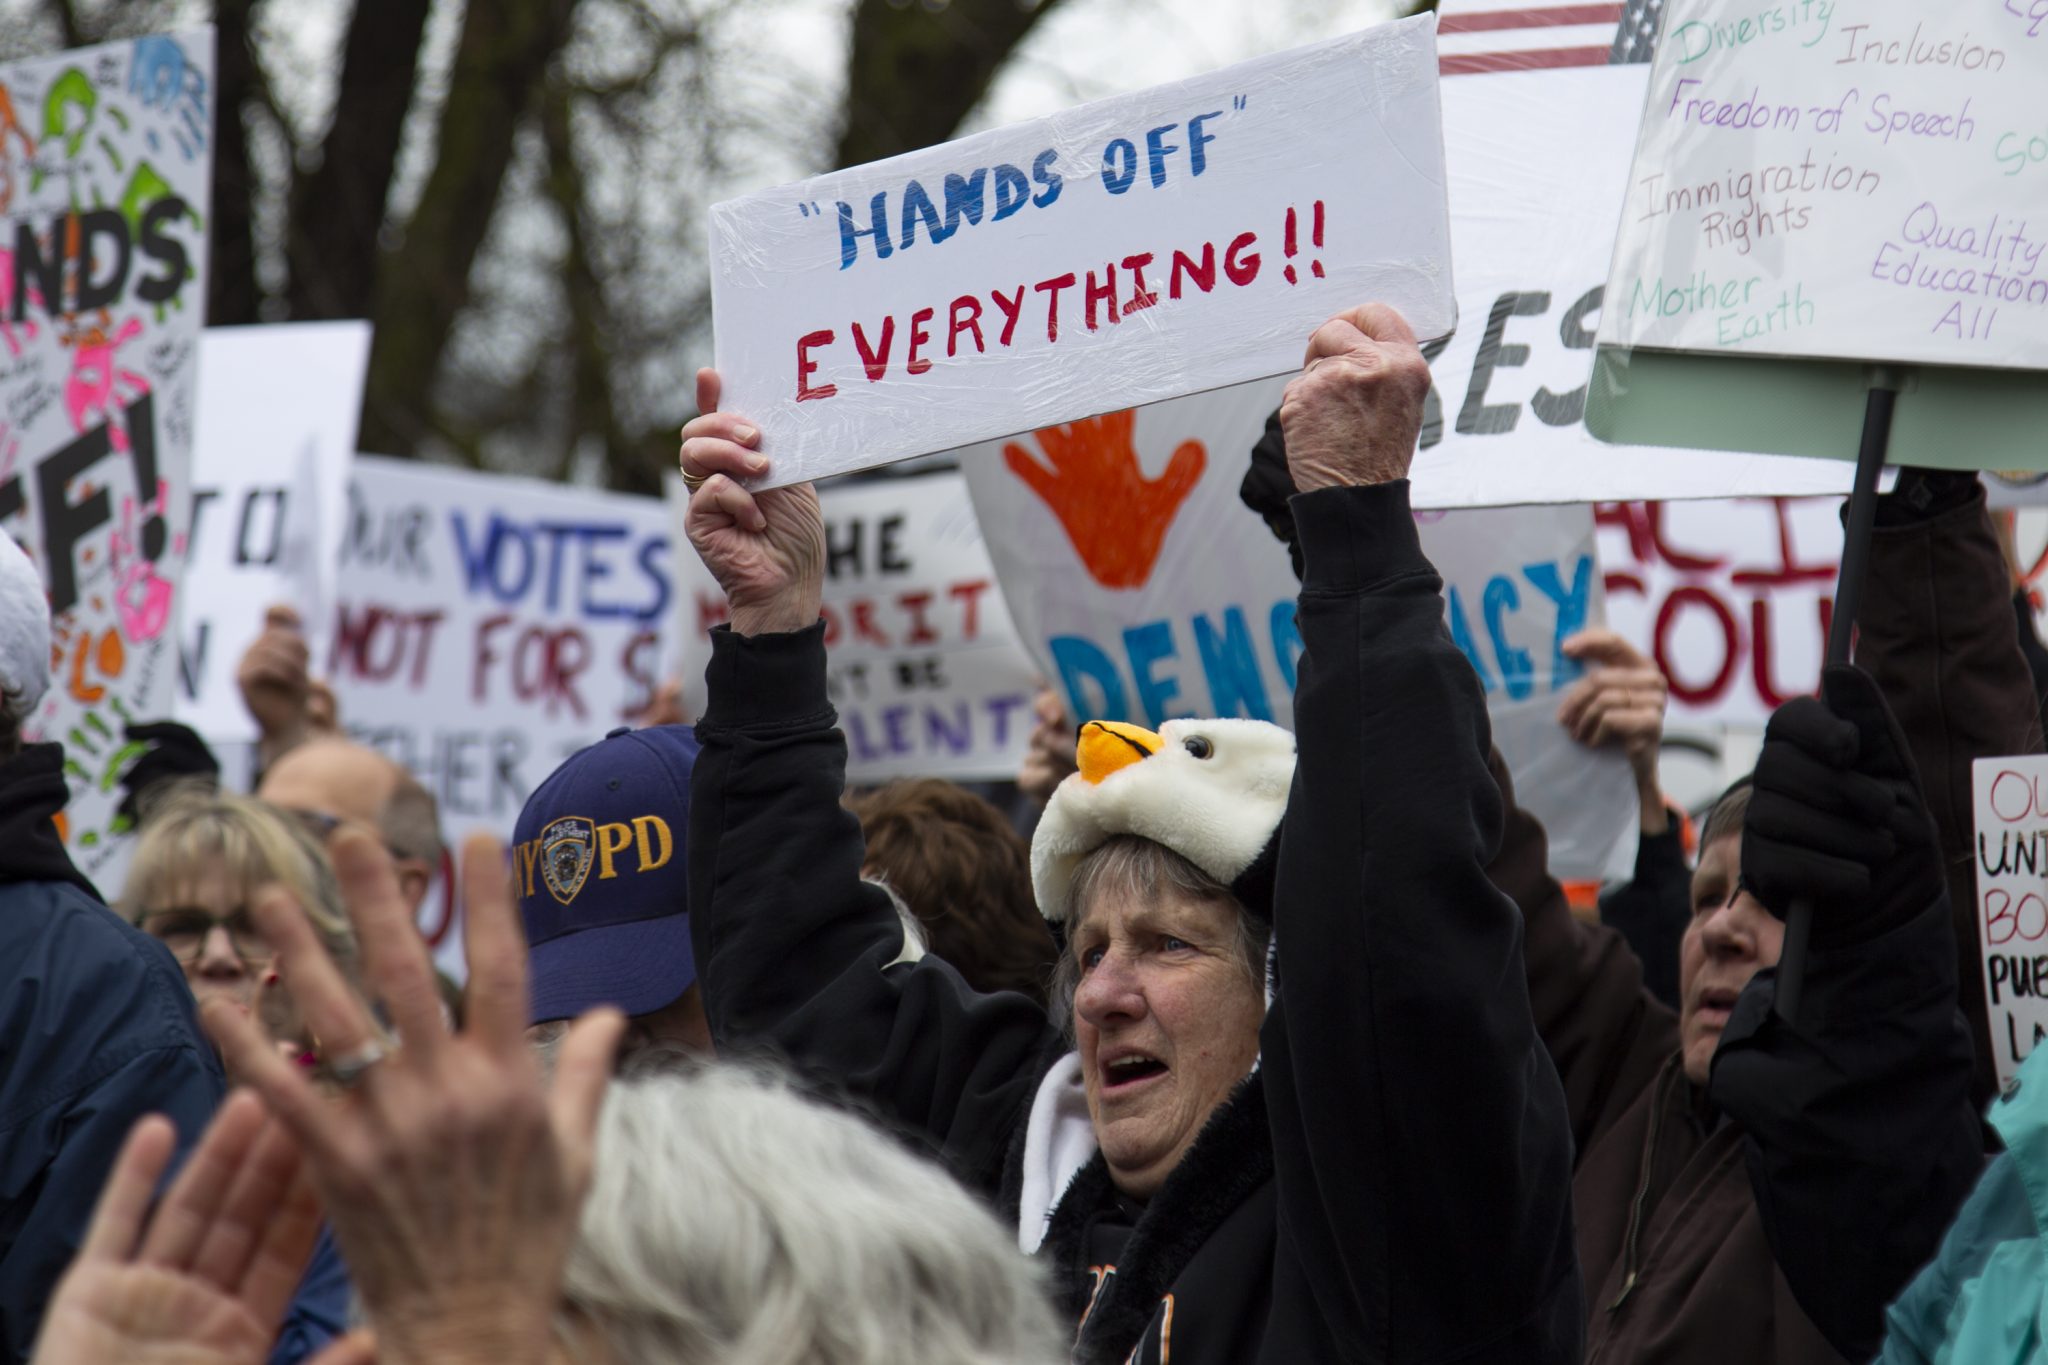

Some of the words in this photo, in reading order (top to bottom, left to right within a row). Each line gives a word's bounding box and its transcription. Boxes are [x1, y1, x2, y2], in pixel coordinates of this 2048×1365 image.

[1671, 0, 1836, 65] Diversity
[1835, 22, 2006, 72] Inclusion
[1667, 78, 1800, 131] Freedom
[1865, 94, 1975, 144] Speech
[1638, 148, 1881, 222] Immigration
[1702, 197, 1813, 255] Rights
[1902, 201, 2048, 277] Quality
[796, 200, 1325, 403] EVERYTHING!!
[1628, 269, 1762, 320] Mother
[1871, 241, 2048, 305] Education
[1716, 281, 1815, 347] Earth
[1931, 300, 1999, 341] All
[1418, 284, 1607, 451] ES
[450, 512, 673, 622] VOTES
[326, 600, 444, 689] NOT
[471, 612, 592, 720] FOR
